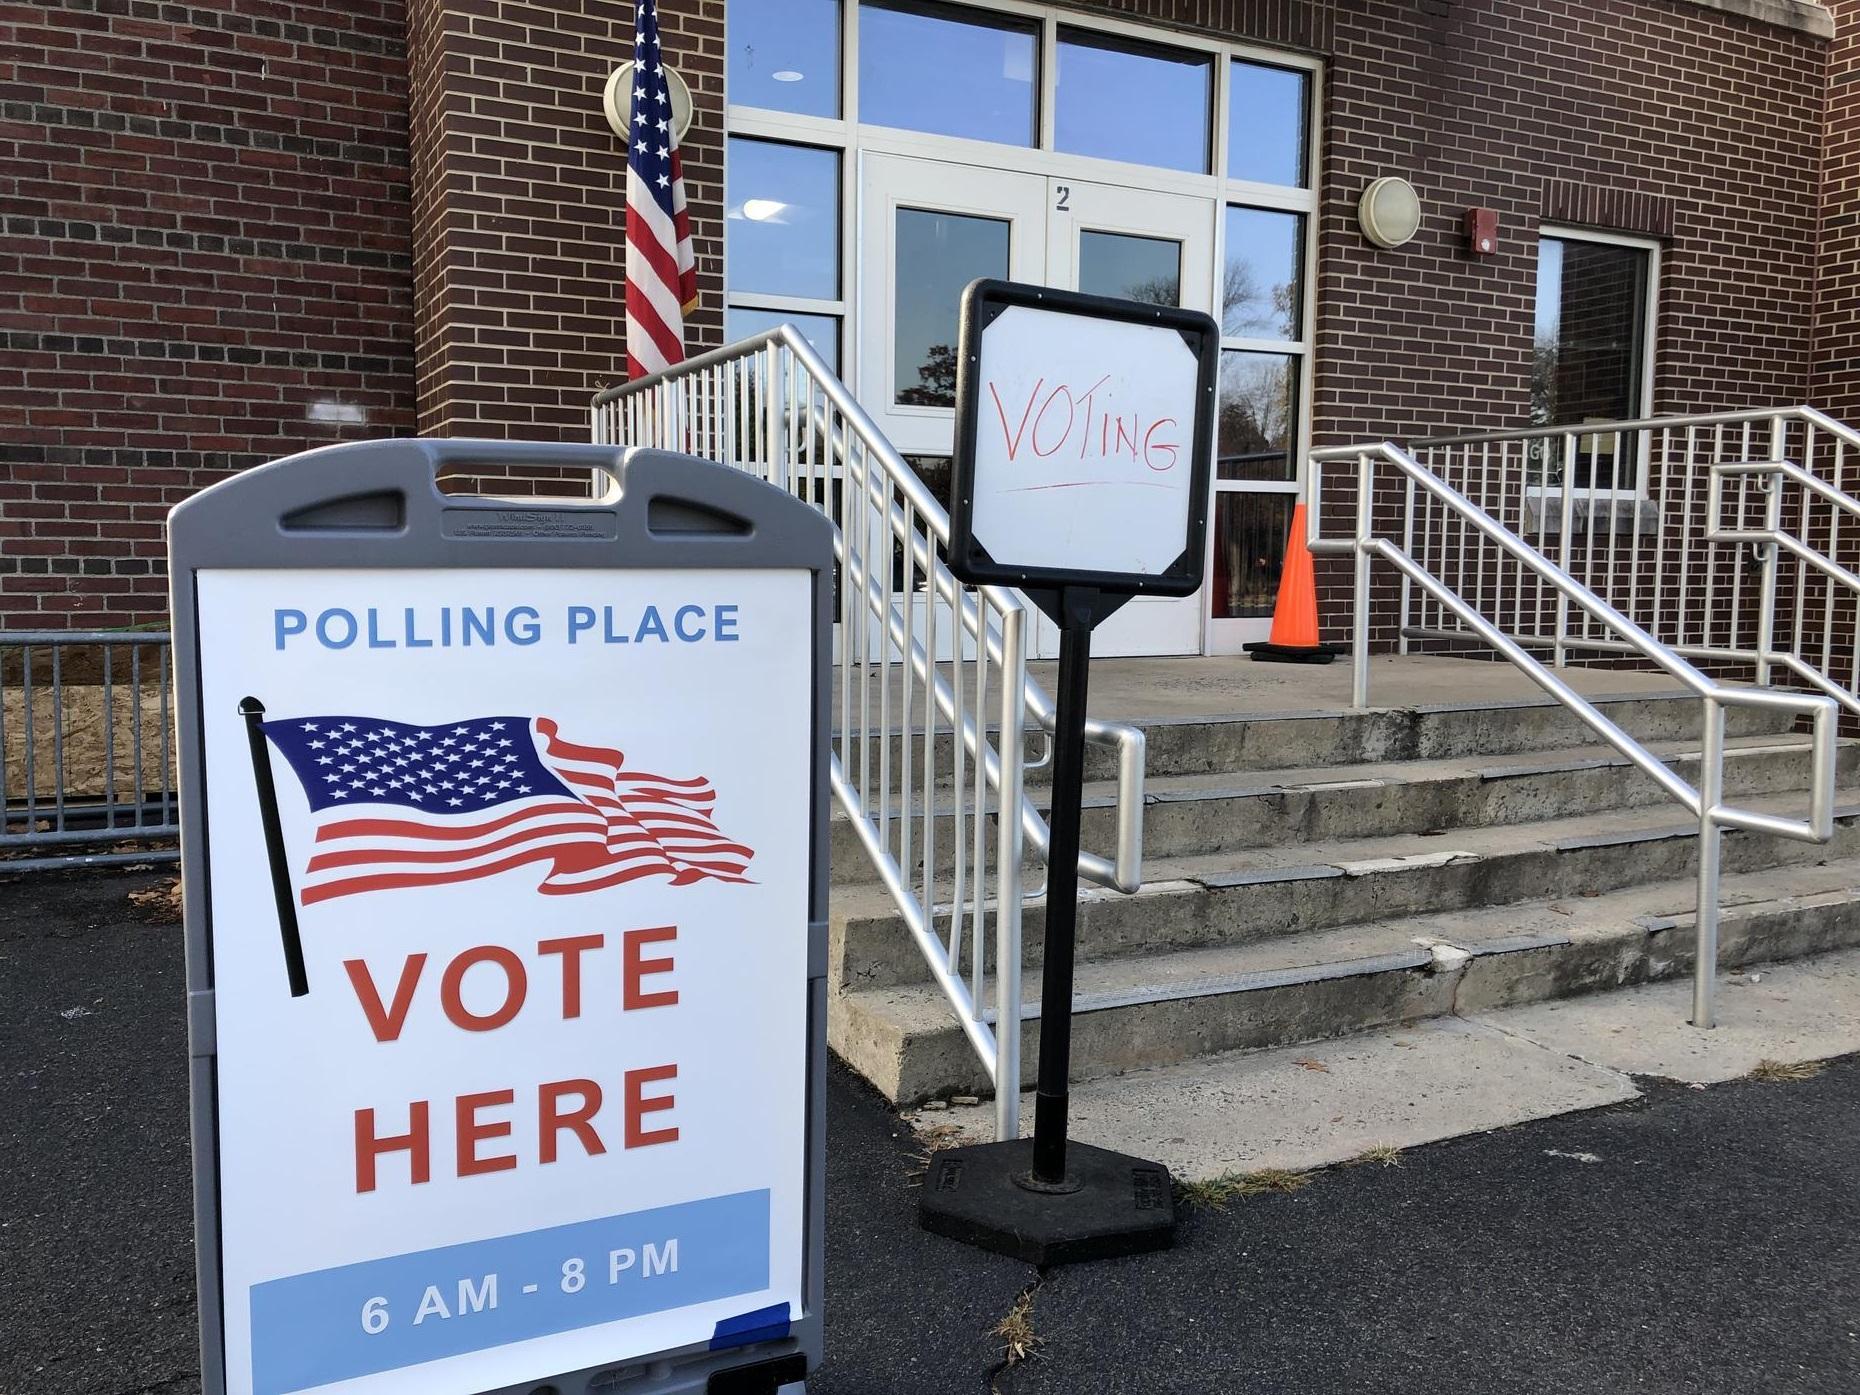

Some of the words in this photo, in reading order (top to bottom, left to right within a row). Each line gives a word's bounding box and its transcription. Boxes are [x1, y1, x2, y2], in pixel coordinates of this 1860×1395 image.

[1056, 186, 1070, 211] 2
[989, 374, 1181, 471] VOTING
[274, 606, 541, 650] POLLING
[567, 604, 740, 645] PLACE
[344, 926, 679, 1043] VOTE
[354, 1064, 680, 1194] HERE
[361, 1296, 389, 1335] 6
[413, 1274, 498, 1326] AM
[522, 1284, 538, 1294] -
[560, 1258, 586, 1294] 8
[609, 1238, 680, 1285] PM
